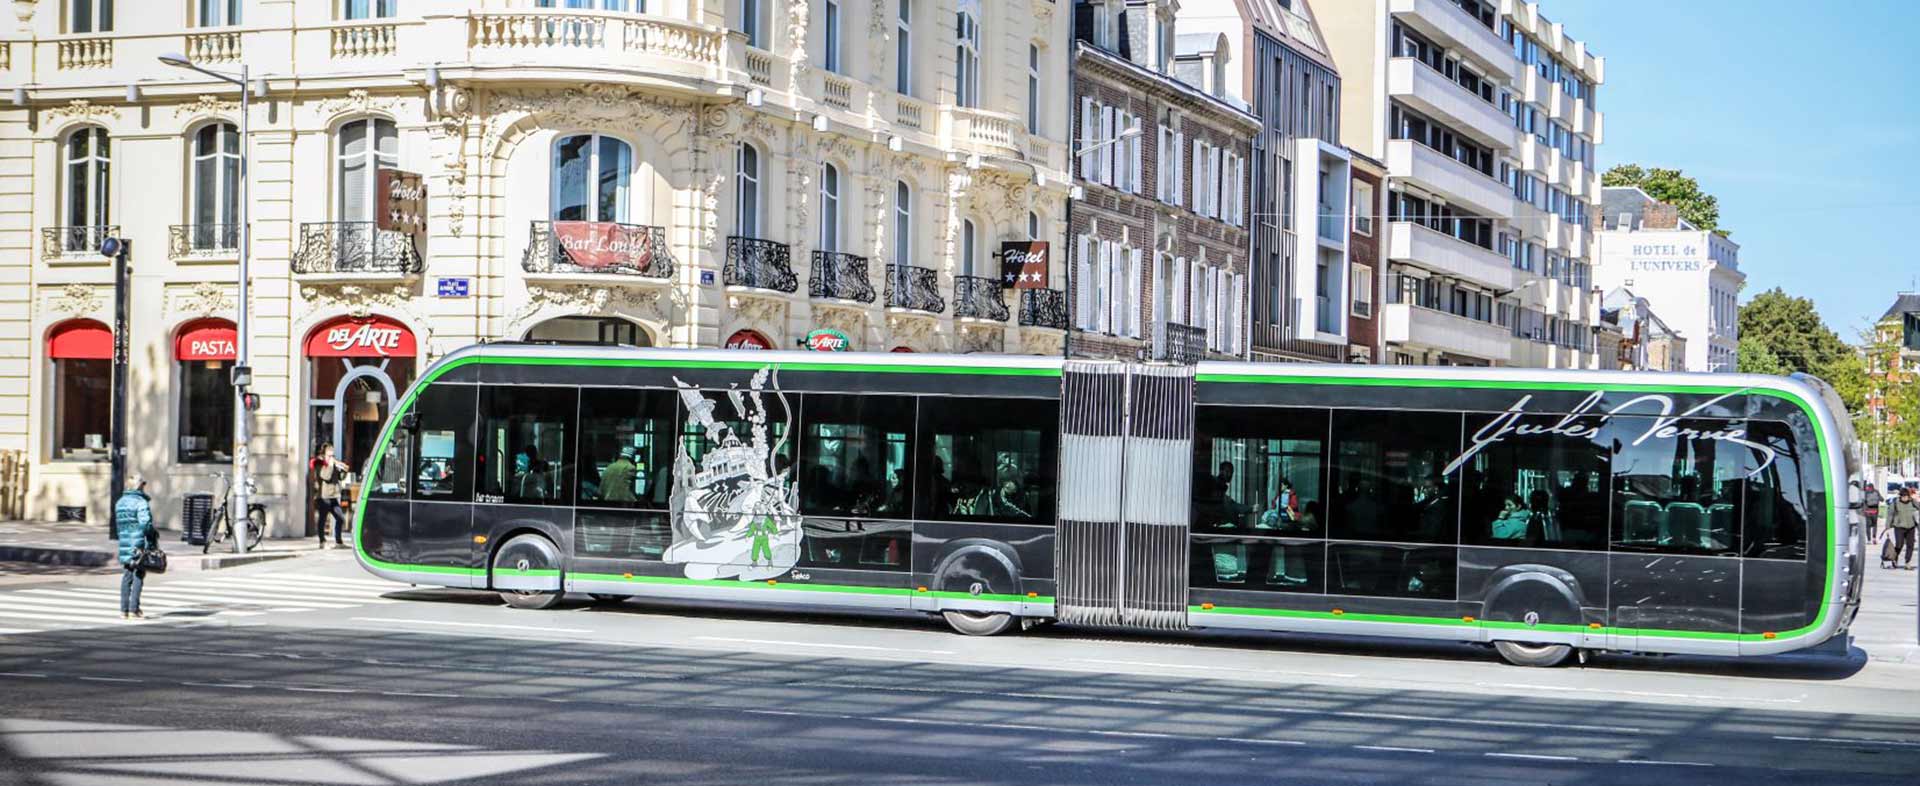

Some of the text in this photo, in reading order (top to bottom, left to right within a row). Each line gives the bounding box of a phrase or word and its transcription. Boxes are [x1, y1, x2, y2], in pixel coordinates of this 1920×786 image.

[390, 180, 422, 200] Hôtel
[560, 235, 591, 250] Bar
[1004, 249, 1045, 263] Hôtel
[1683, 246, 1697, 256] de
[1631, 261, 1701, 271] L'UNIVERS
[328, 323, 402, 355] DEL ARTE
[191, 340, 236, 356] PASTA
[1442, 387, 1775, 477] Jules Verne
